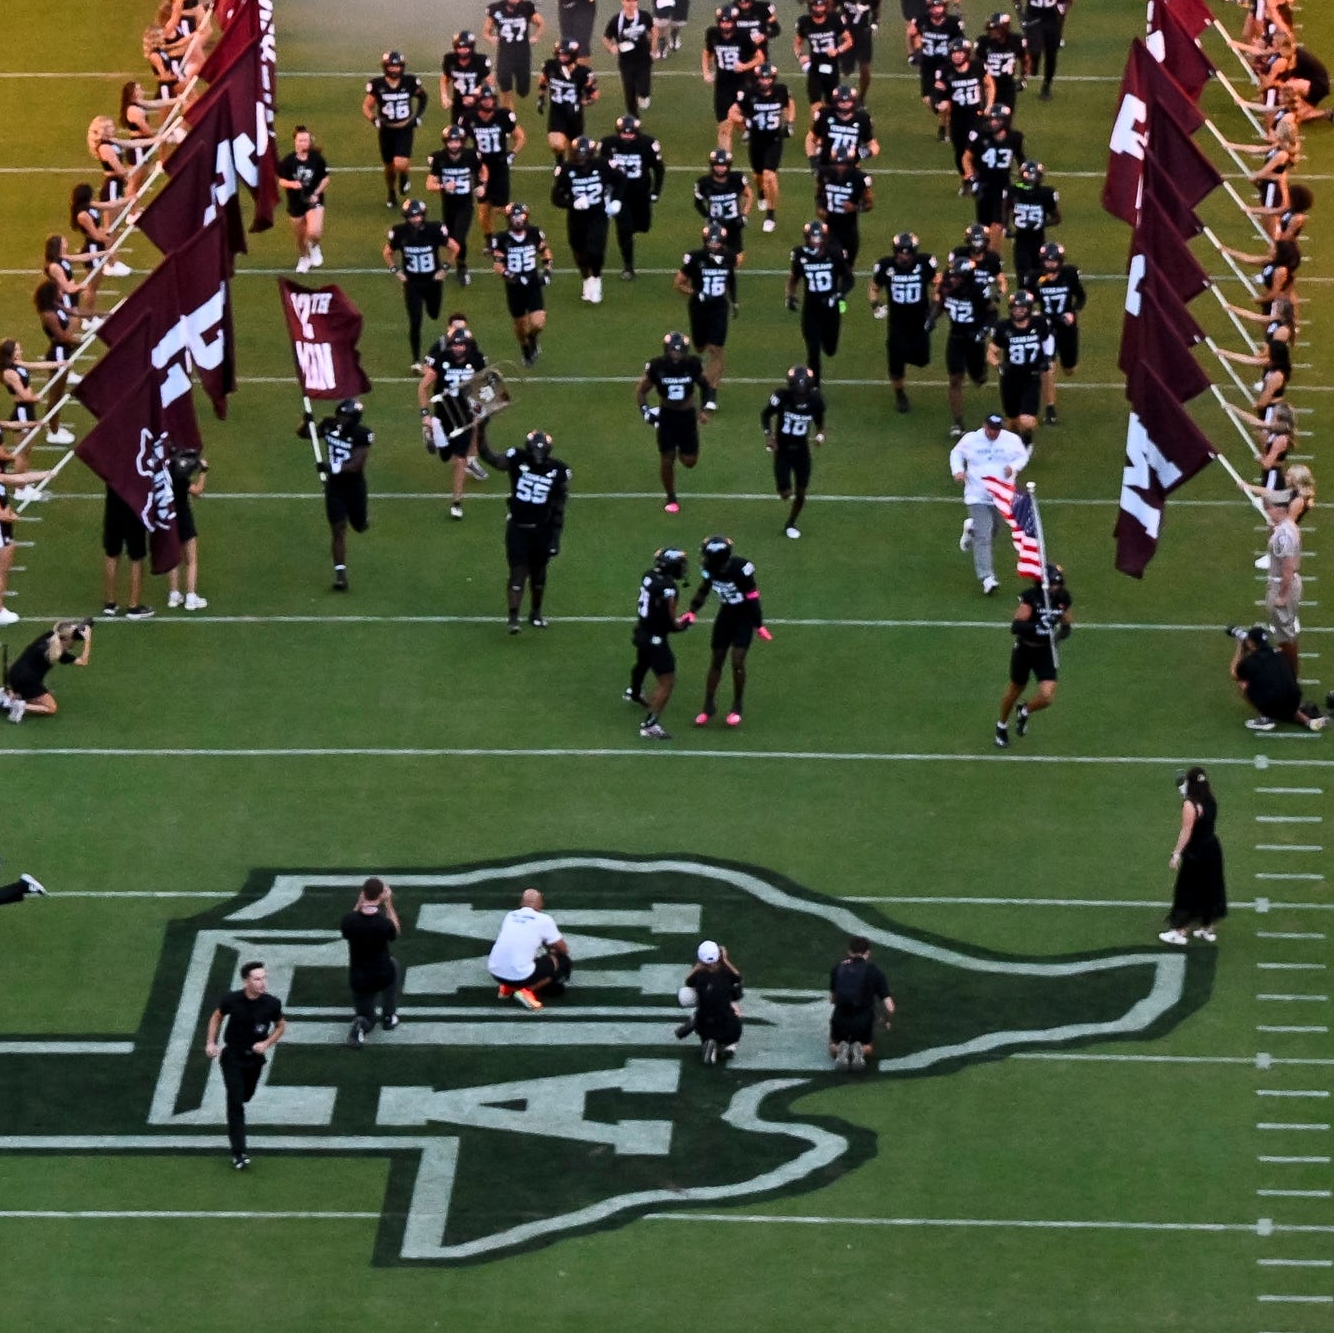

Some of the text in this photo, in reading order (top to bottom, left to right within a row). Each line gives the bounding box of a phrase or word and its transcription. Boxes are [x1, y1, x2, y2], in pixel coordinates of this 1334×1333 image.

[951, 85, 981, 105] 40
[382, 103, 410, 120] 46
[982, 147, 1014, 169] 43
[405, 254, 436, 274] 38
[507, 252, 536, 273] 85
[701, 276, 725, 297] 16
[1041, 292, 1066, 314] 17
[1009, 342, 1042, 365] 87
[514, 474, 551, 504] 55
